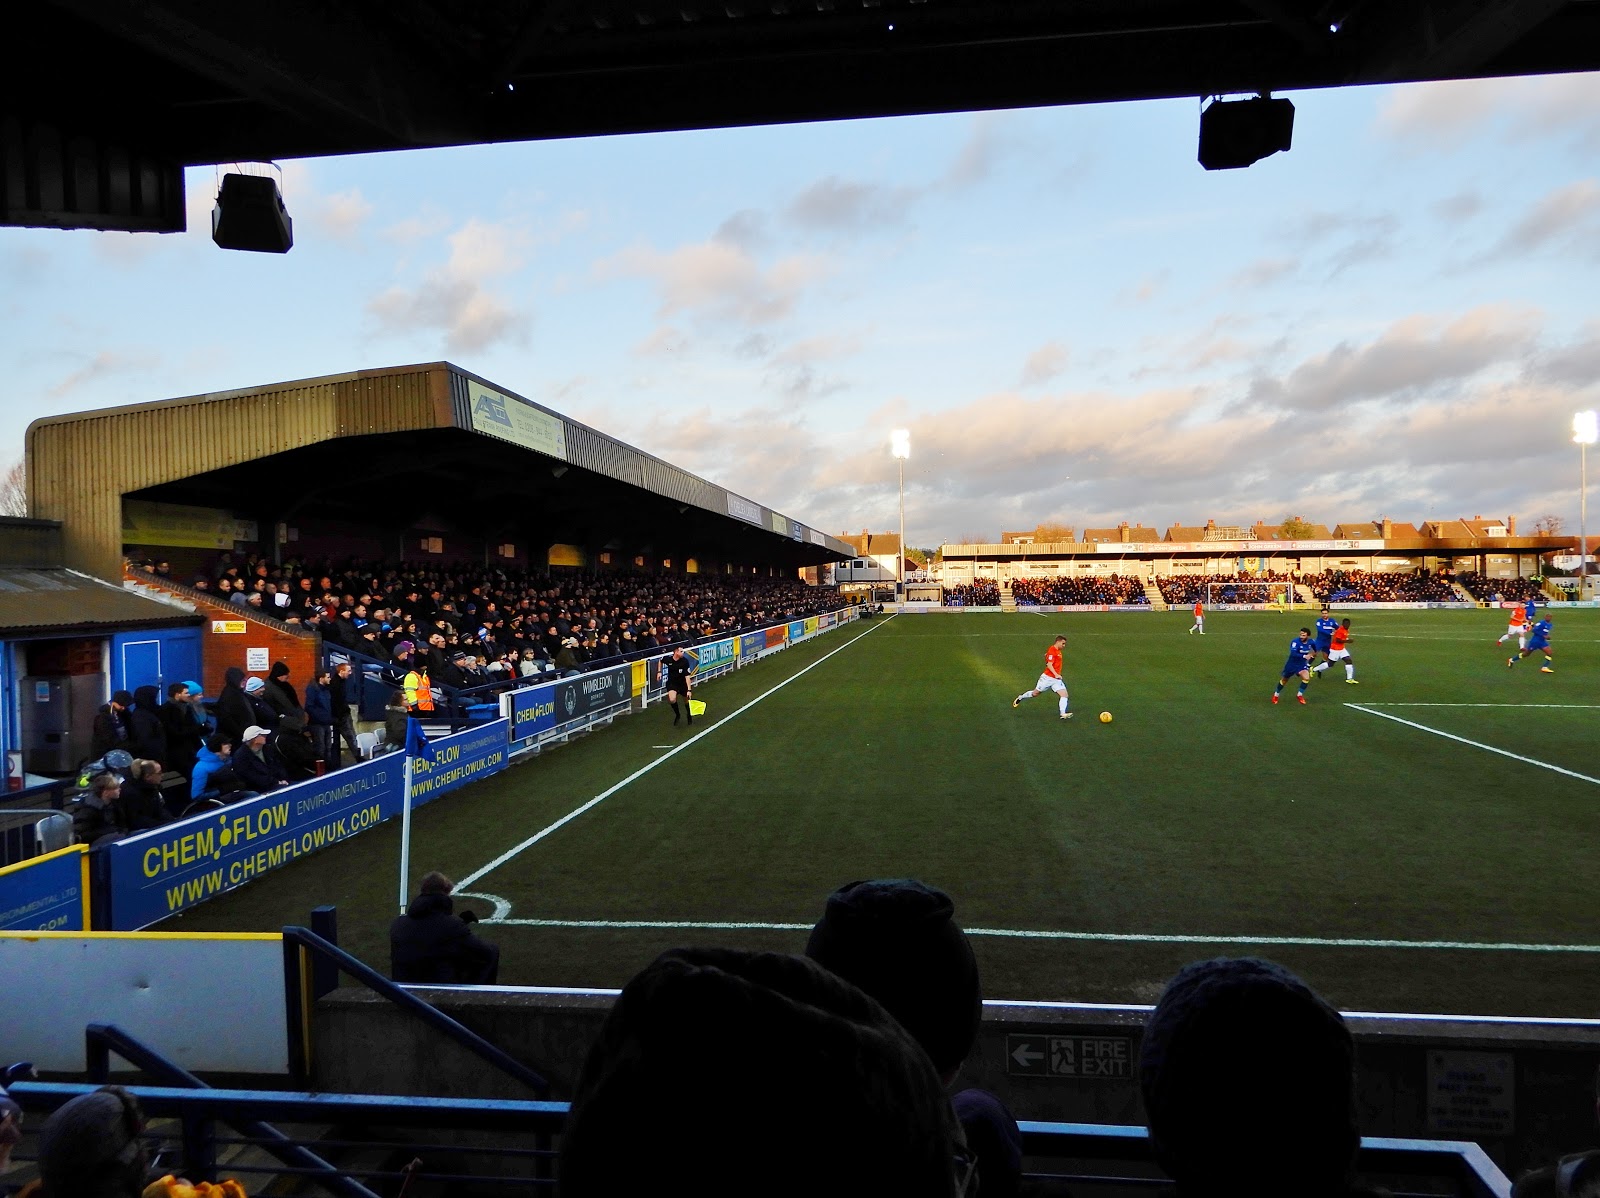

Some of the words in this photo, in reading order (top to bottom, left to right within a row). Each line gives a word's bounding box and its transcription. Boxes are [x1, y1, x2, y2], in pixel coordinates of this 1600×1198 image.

[582, 674, 613, 695] WIMBLEDON
[516, 707, 535, 724] CHEM
[538, 701, 555, 717] FLOW
[436, 745, 460, 765] FLOW
[411, 751, 503, 798] WWW.CHEMFLOWUK.COM
[143, 827, 214, 878] CHEM
[233, 801, 290, 845] FLOW
[296, 779, 371, 816] ENVIRONMENTAL
[372, 771, 387, 787] LTD
[166, 803, 380, 911] WWW.CHEMFLOWUK.COM
[61, 887, 77, 899] LTD
[1081, 1040, 1127, 1058] FIRE
[1081, 1057, 1128, 1076] EXIT
